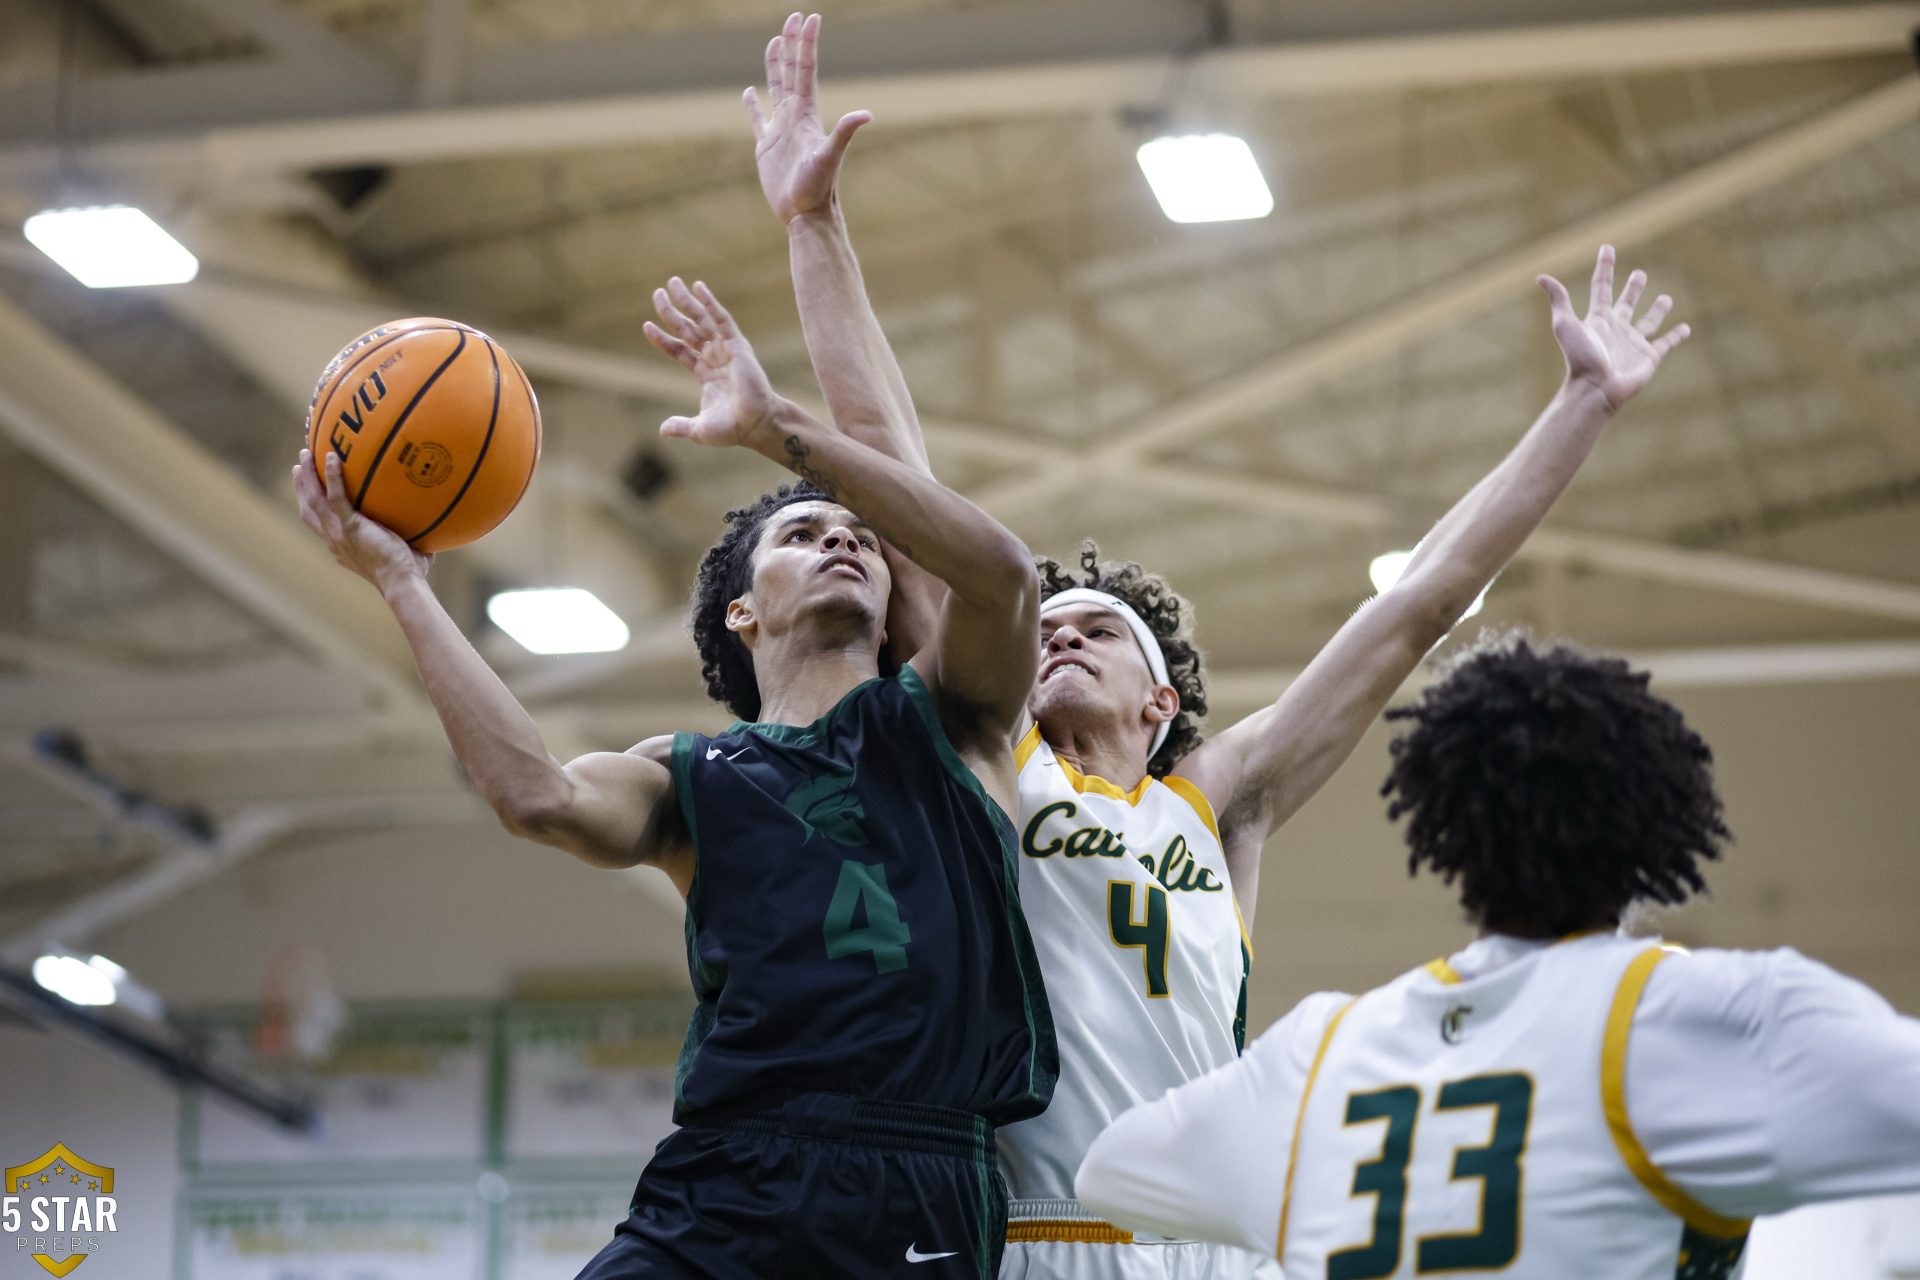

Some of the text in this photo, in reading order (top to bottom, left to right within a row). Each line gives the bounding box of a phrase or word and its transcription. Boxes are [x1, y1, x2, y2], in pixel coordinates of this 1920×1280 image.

[329, 370, 388, 464] EVO
[823, 859, 911, 975] 4
[1107, 879, 1171, 998] 4
[1325, 1069, 1536, 1280] 33
